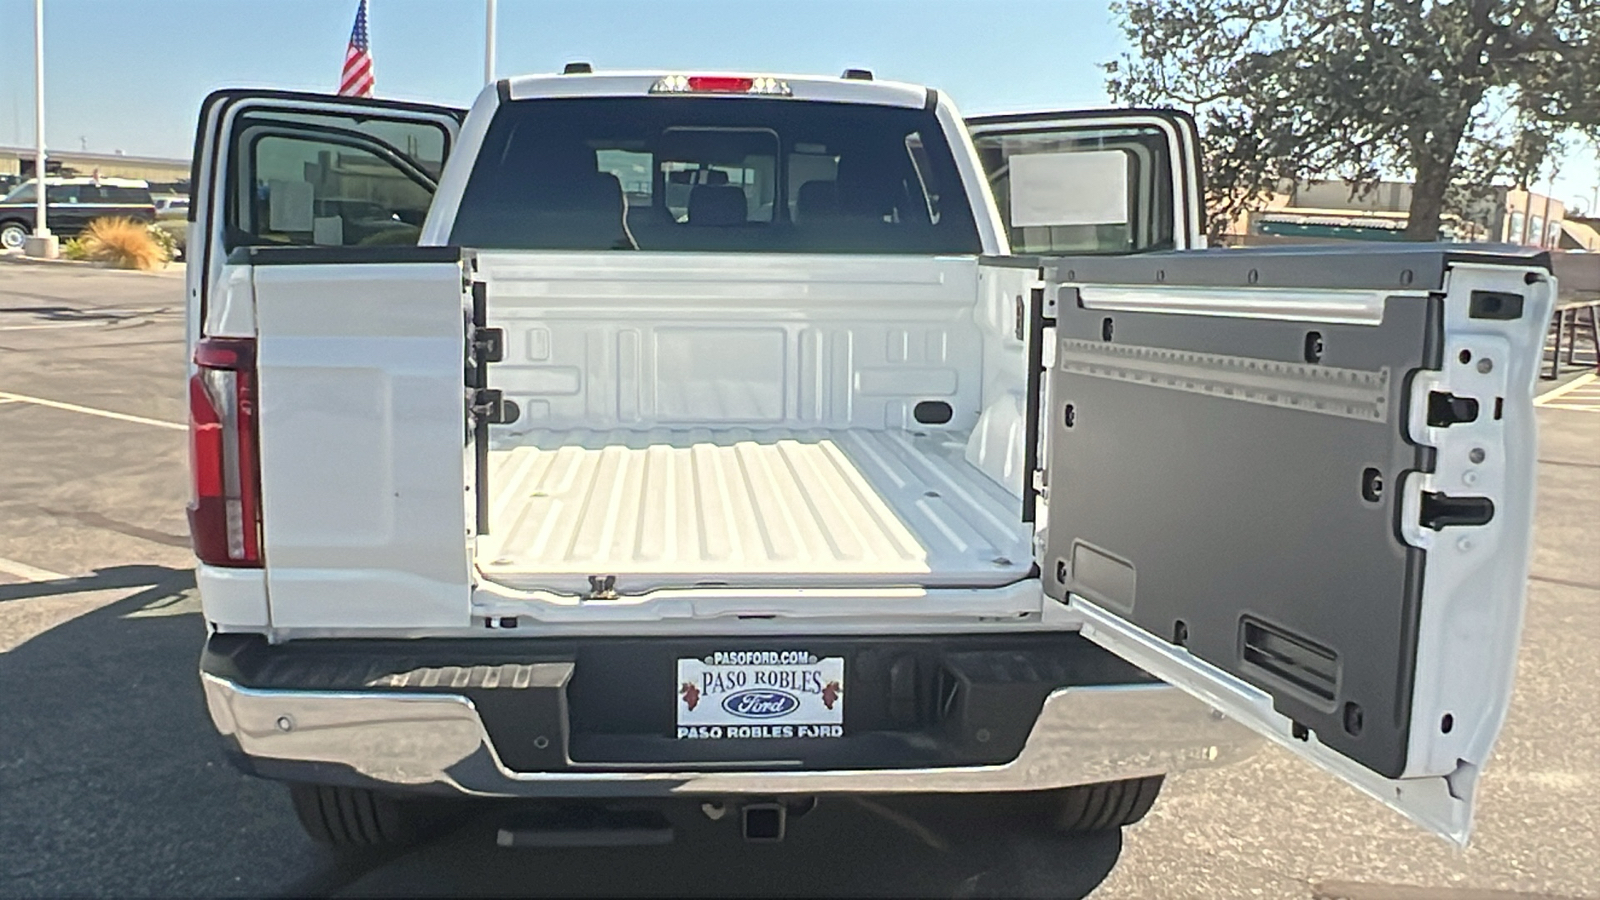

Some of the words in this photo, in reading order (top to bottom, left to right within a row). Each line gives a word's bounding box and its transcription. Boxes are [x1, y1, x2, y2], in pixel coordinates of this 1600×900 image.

[714, 651, 809, 664] PASOFORD.COM
[702, 670, 747, 696] PASO
[754, 670, 822, 695] ROBLES
[737, 693, 785, 713] Ford
[677, 727, 723, 739] PASO
[727, 726, 793, 738] ROBLES
